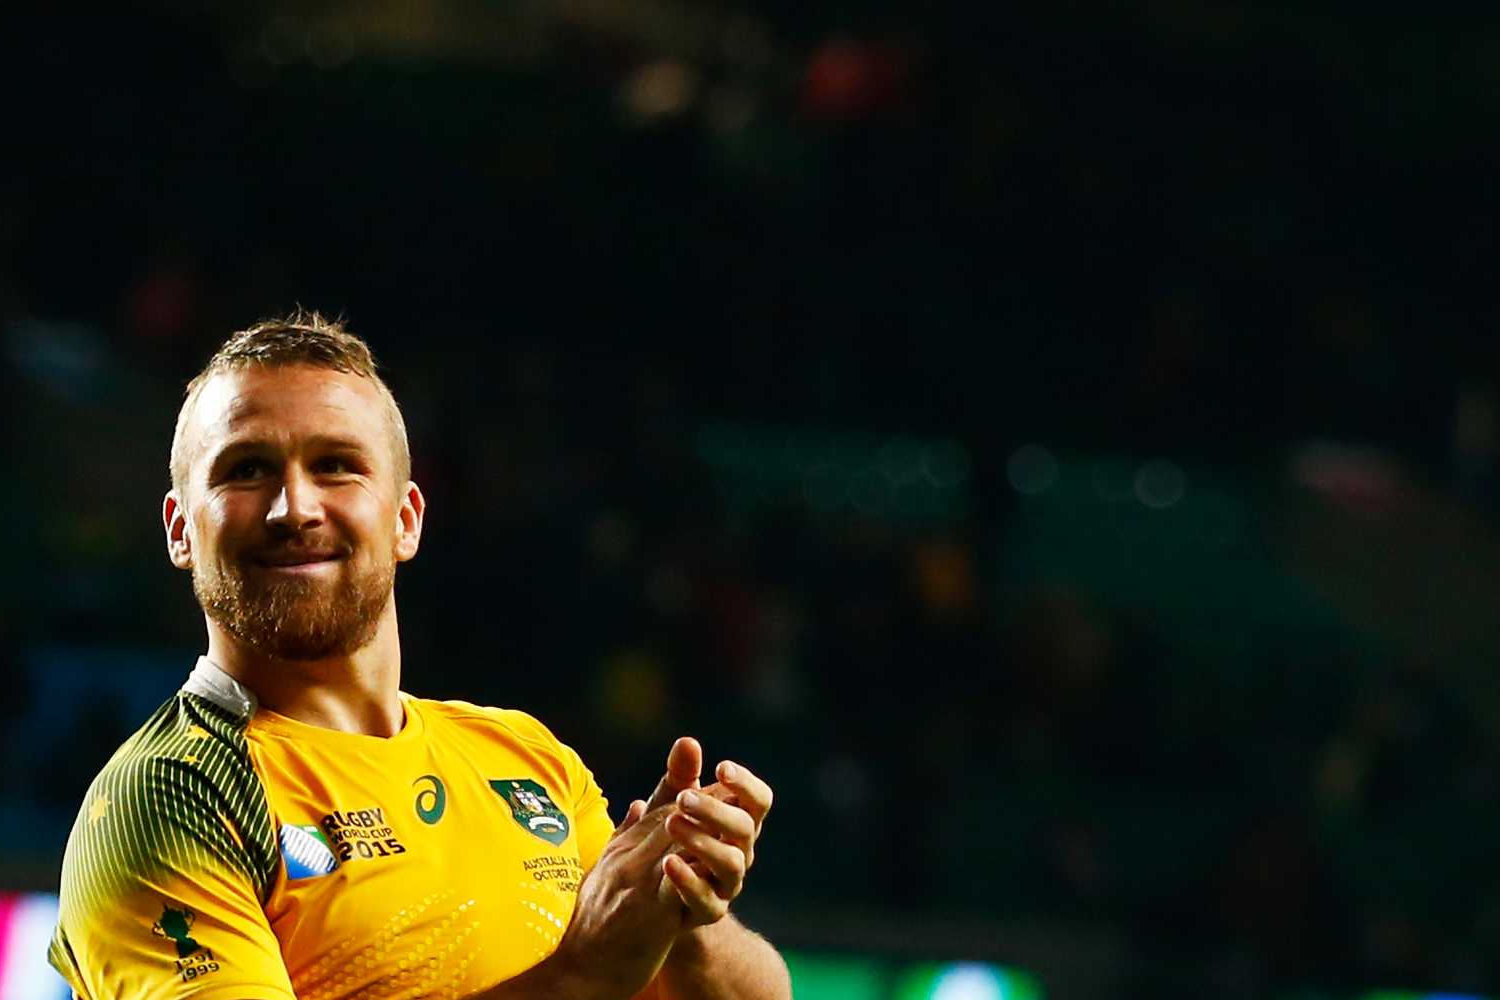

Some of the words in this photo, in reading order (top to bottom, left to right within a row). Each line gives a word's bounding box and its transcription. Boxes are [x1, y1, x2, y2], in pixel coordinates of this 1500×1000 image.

[321, 808, 384, 835] RUGBY
[370, 827, 392, 838] CUP
[339, 838, 406, 861] 2015
[523, 856, 568, 870] AUSTRALIA
[182, 962, 220, 983] 1999
